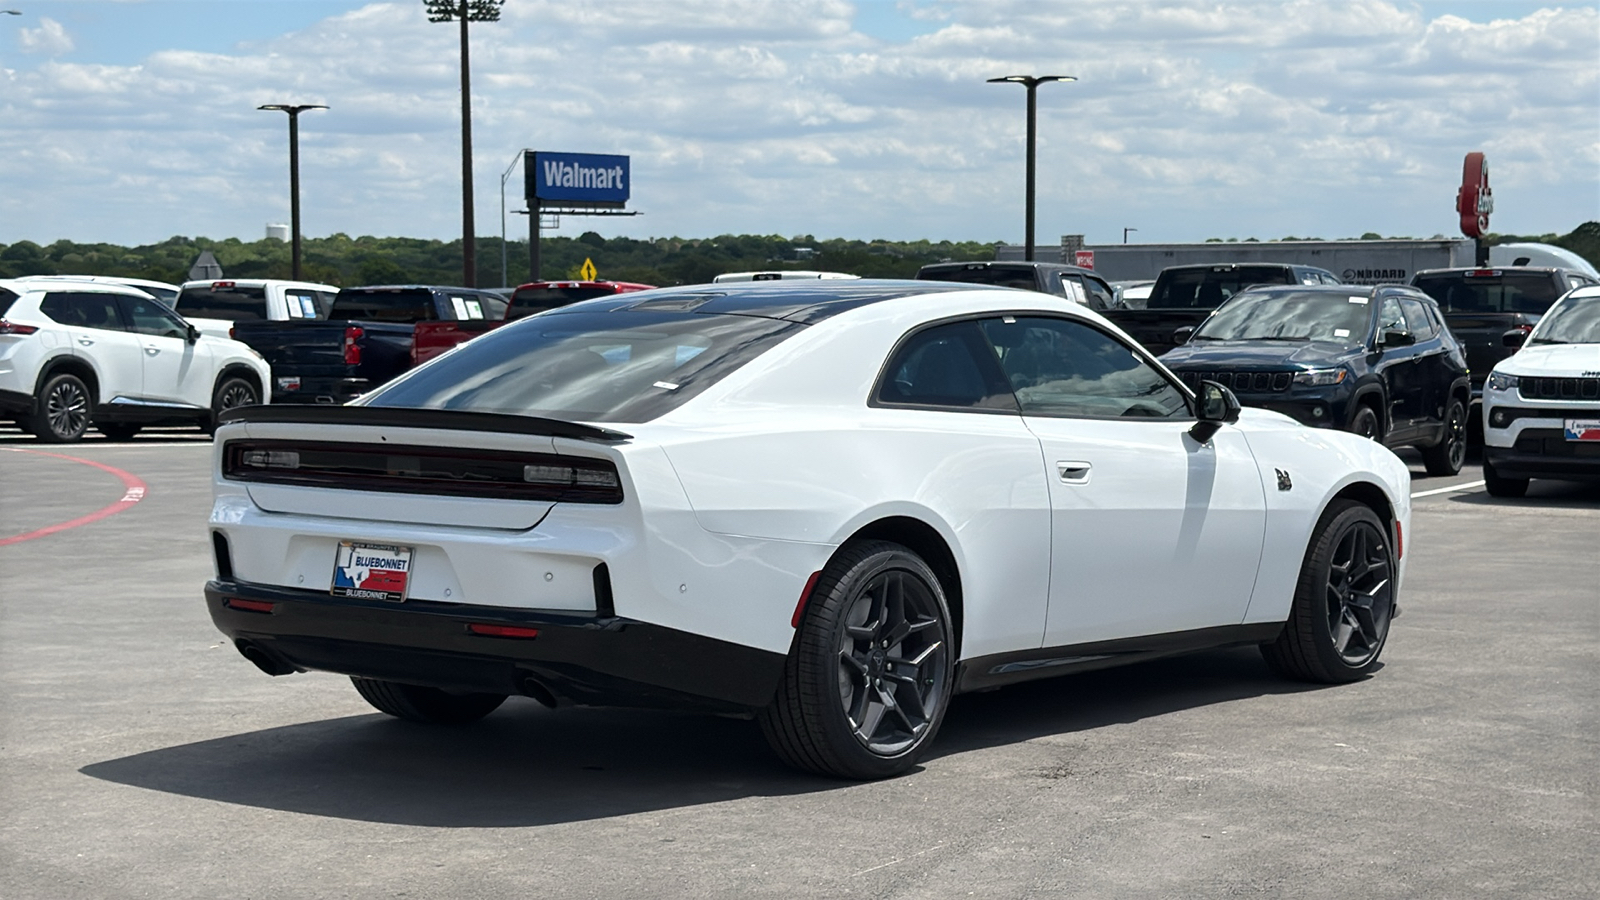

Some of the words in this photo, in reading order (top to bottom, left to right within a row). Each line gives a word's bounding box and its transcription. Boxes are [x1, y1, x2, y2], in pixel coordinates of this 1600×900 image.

[543, 160, 624, 190] Walmart
[355, 556, 407, 570] BLUEBONNET
[346, 588, 388, 600] BLUEBONNET
